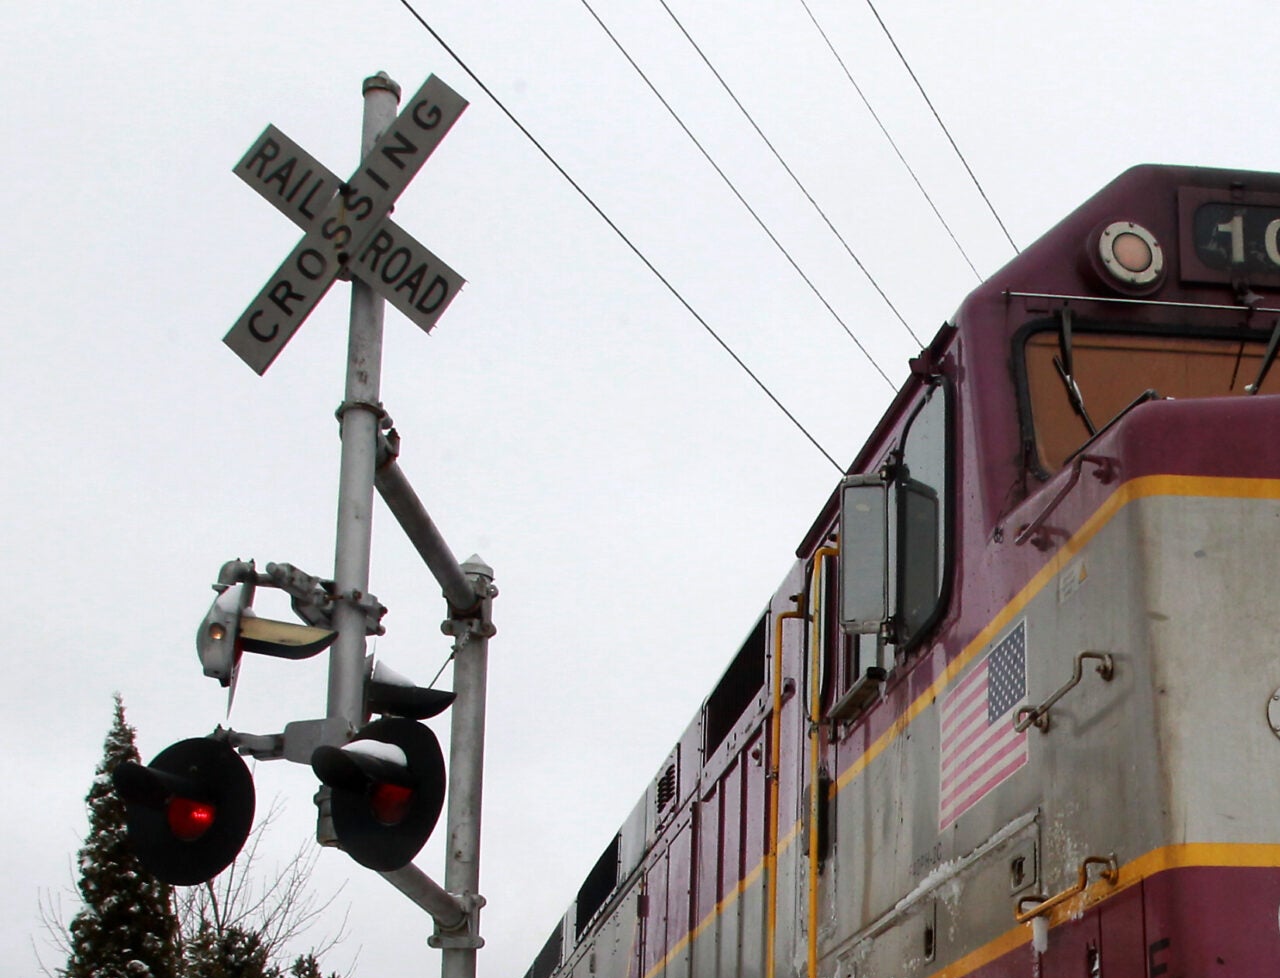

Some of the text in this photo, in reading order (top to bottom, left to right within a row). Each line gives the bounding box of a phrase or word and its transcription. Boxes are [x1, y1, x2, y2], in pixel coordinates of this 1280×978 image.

[246, 138, 324, 220] RAIL
[247, 100, 442, 343] CROSSING
[359, 229, 449, 315] ROAD
